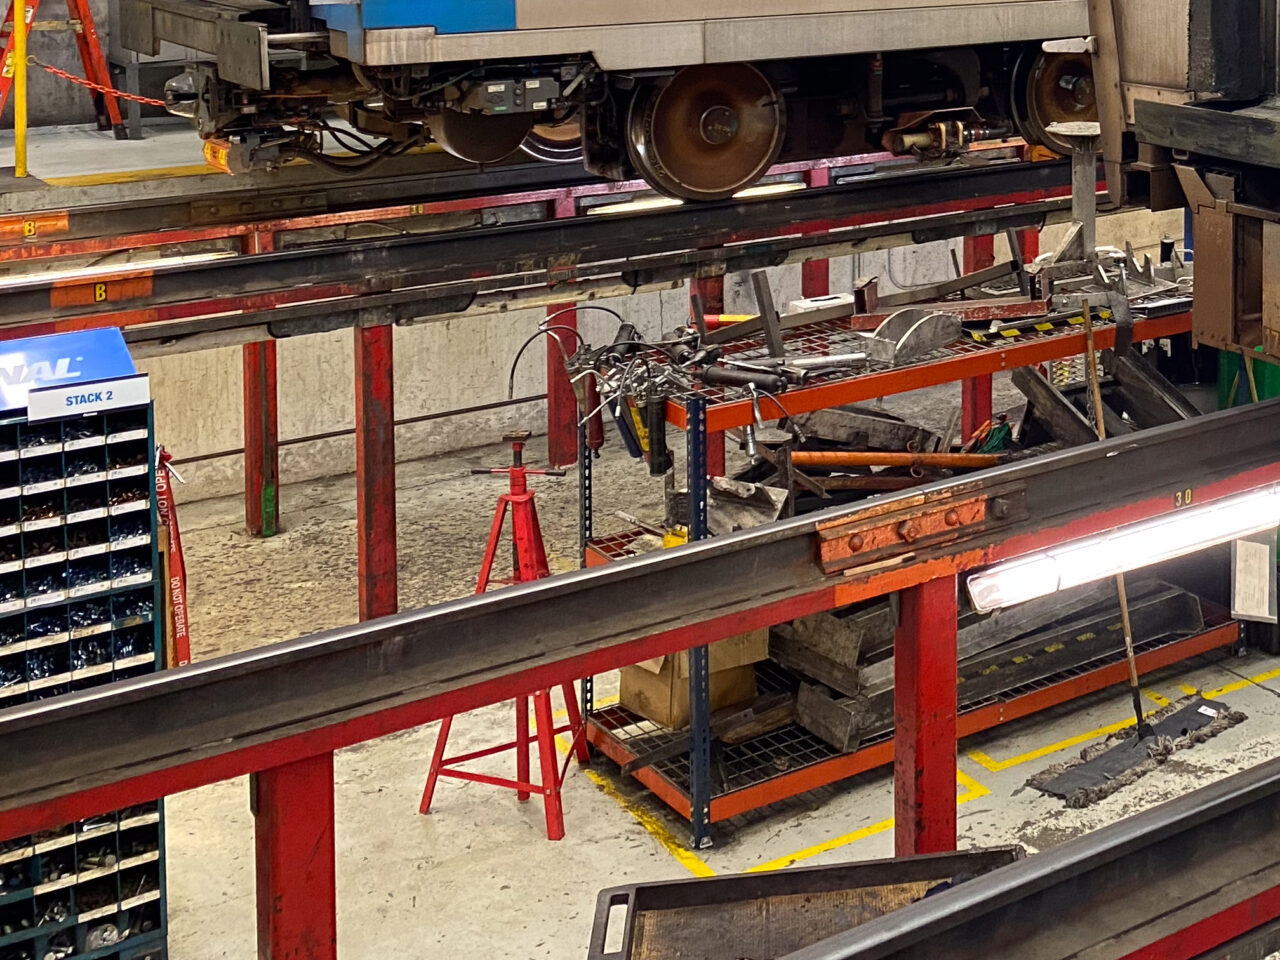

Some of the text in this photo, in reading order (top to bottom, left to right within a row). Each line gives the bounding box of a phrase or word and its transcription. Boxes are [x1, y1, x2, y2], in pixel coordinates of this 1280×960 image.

[95, 283, 107, 302] B
[65, 390, 114, 407] STACK 2
[1175, 488, 1192, 507] 30
[174, 605, 187, 639] OPERATE
